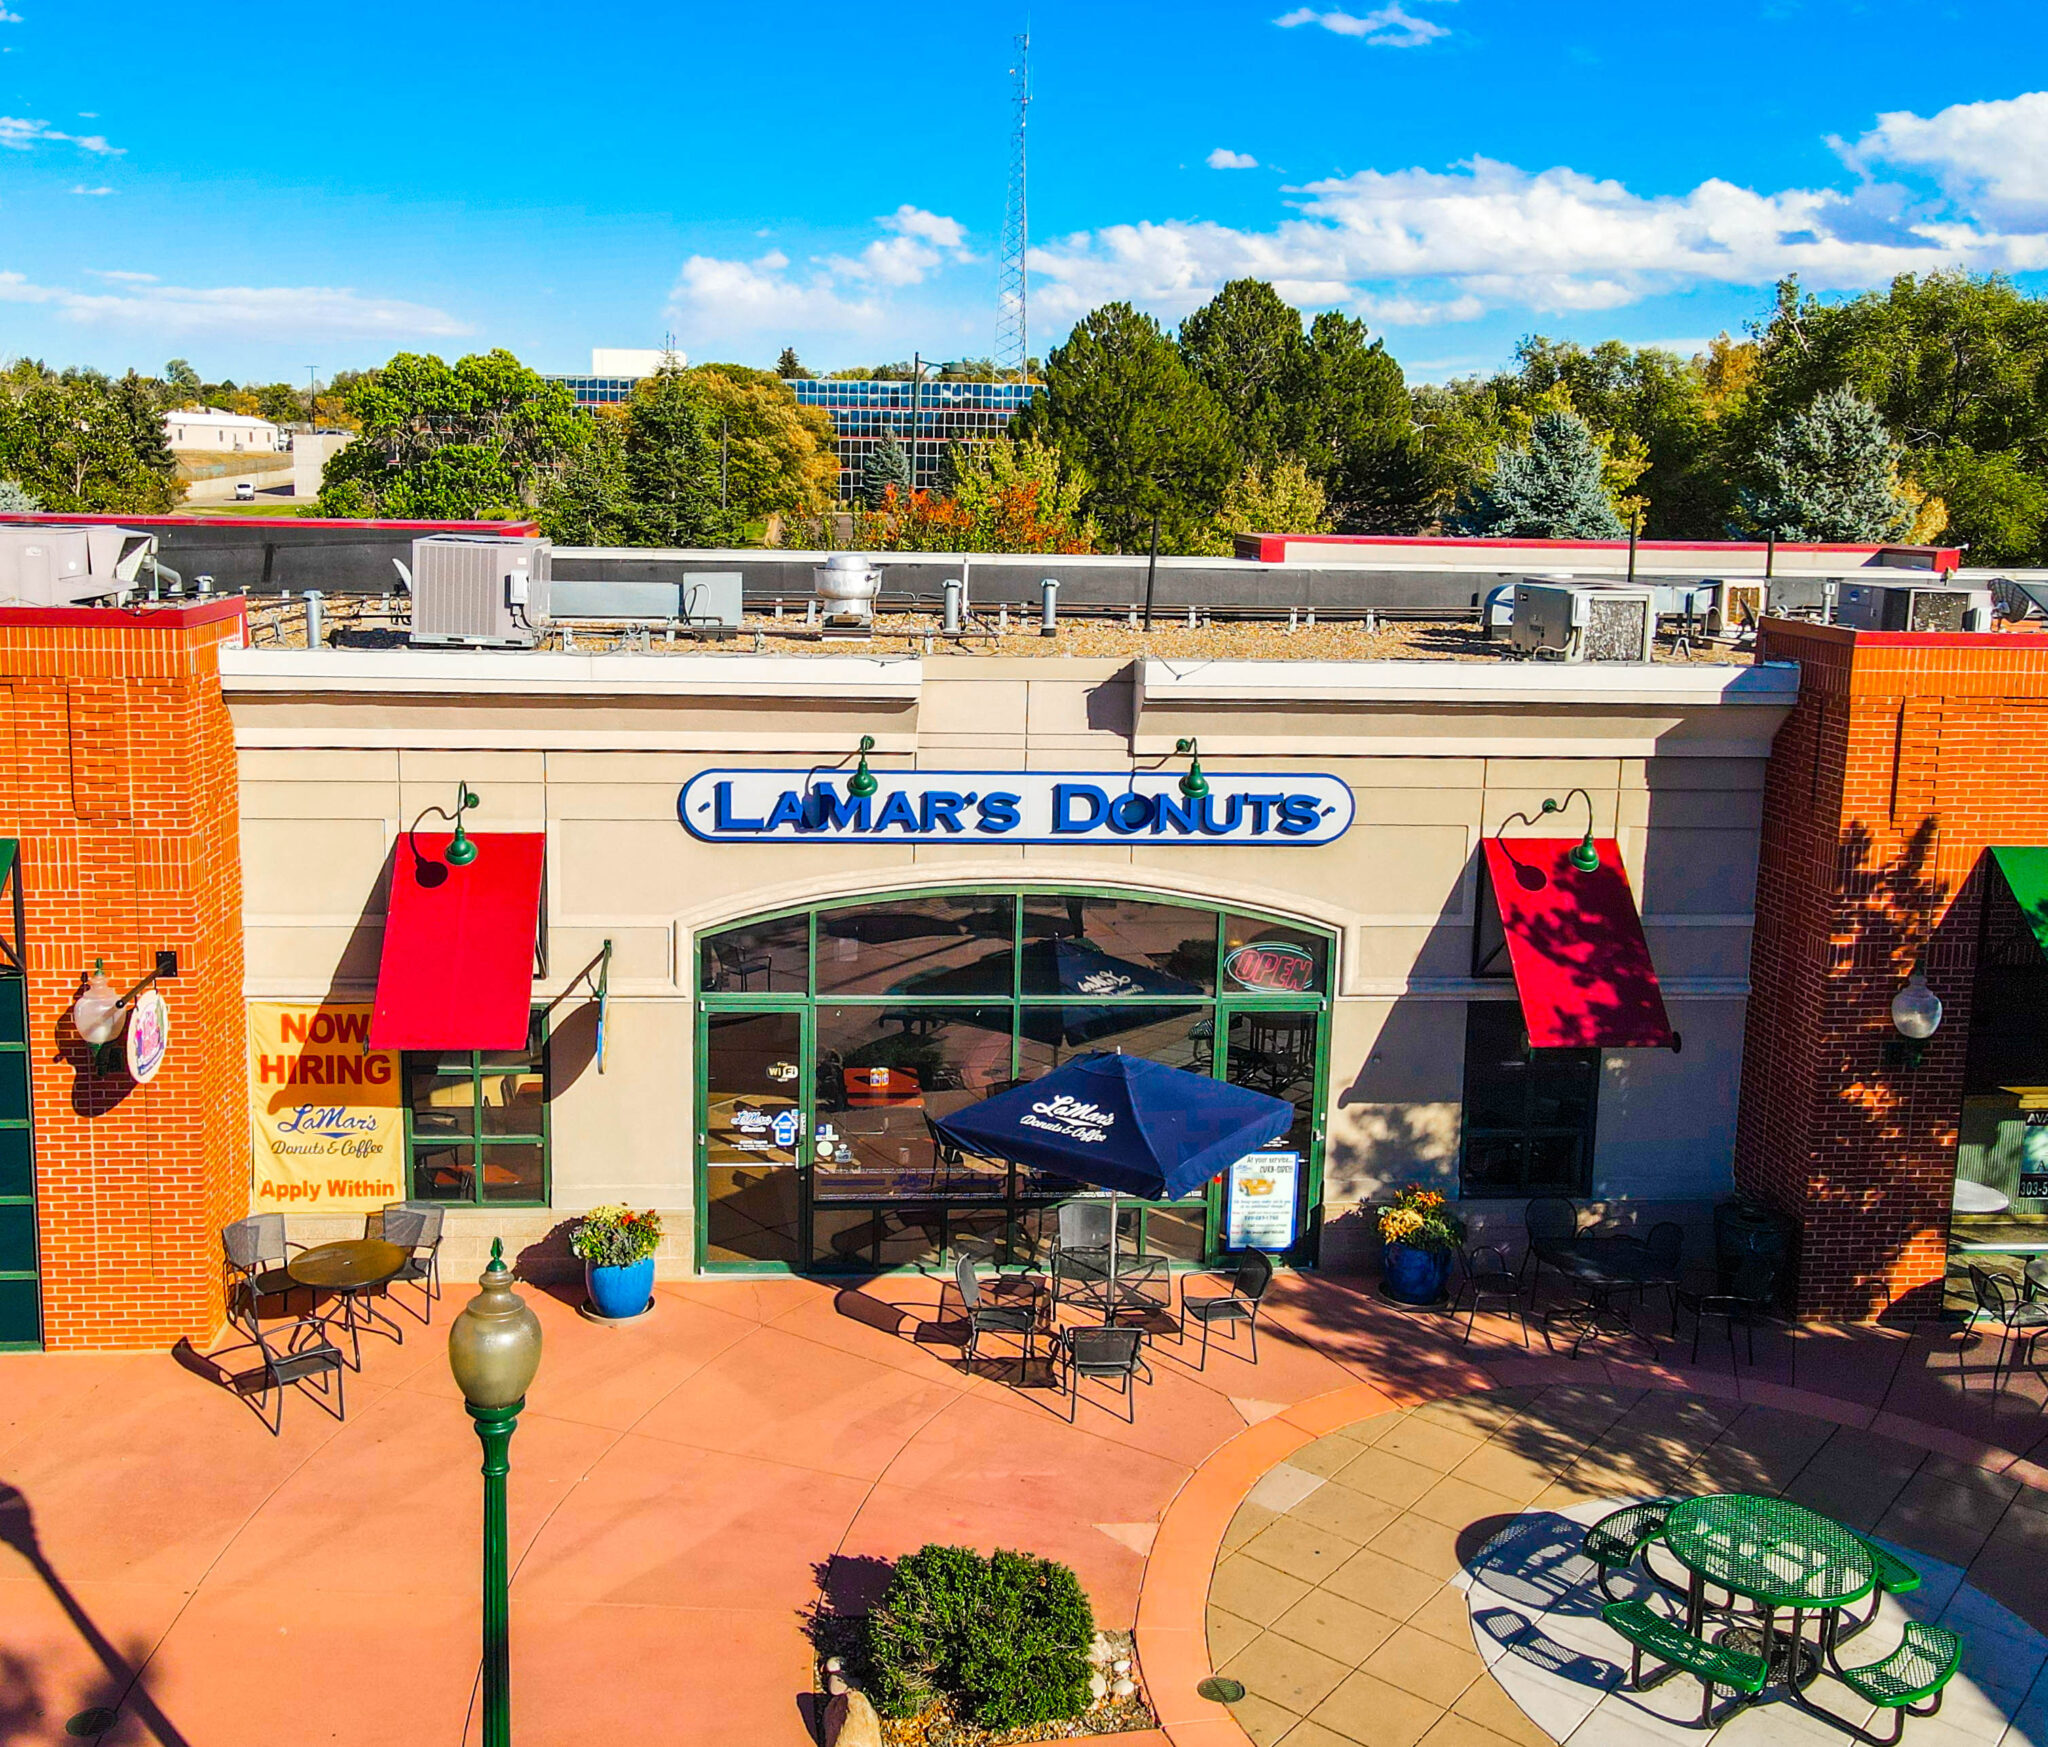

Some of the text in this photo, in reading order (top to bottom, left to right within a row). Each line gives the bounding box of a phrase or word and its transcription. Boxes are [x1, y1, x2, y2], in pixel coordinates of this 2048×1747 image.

[1050, 783, 1322, 835] DONUTS
[1235, 949, 1313, 991] OPEN
[280, 1013, 370, 1044] NOW
[260, 1054, 391, 1085] HIRING
[277, 1104, 379, 1134] LaMar's
[1032, 1095, 1115, 1126] LaMar's
[1020, 1114, 1107, 1142] Donuts & Coffee
[271, 1139, 383, 1159] Donuts & Coffee
[260, 1179, 395, 1201] Apply Within
